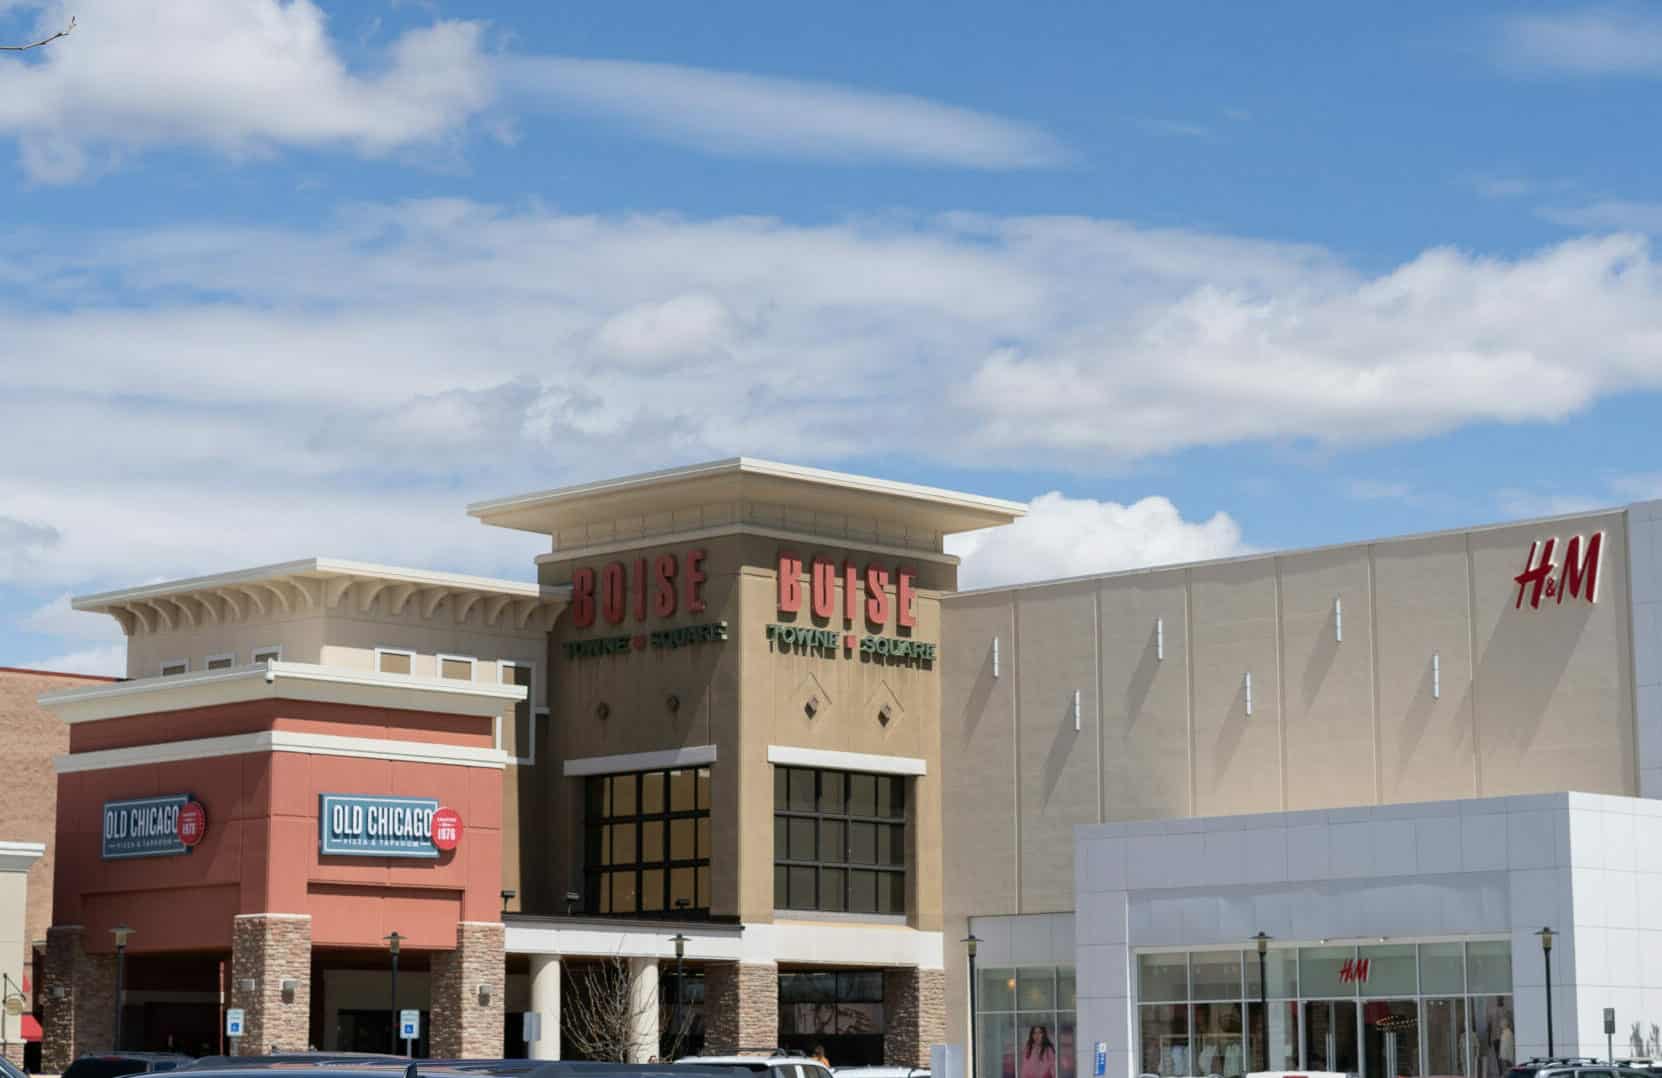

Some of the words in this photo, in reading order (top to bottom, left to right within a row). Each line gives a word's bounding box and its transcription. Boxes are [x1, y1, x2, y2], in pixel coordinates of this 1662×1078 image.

[573, 549, 705, 628] BOISE
[778, 553, 917, 627] BOISE
[1514, 532, 1605, 609] H&M
[766, 623, 840, 650] TOWNE
[861, 635, 936, 661] SQUARE
[106, 810, 127, 839] OLD
[130, 805, 179, 838] CHICAGO
[333, 804, 362, 834] OLD
[367, 806, 432, 837] CHICAGO
